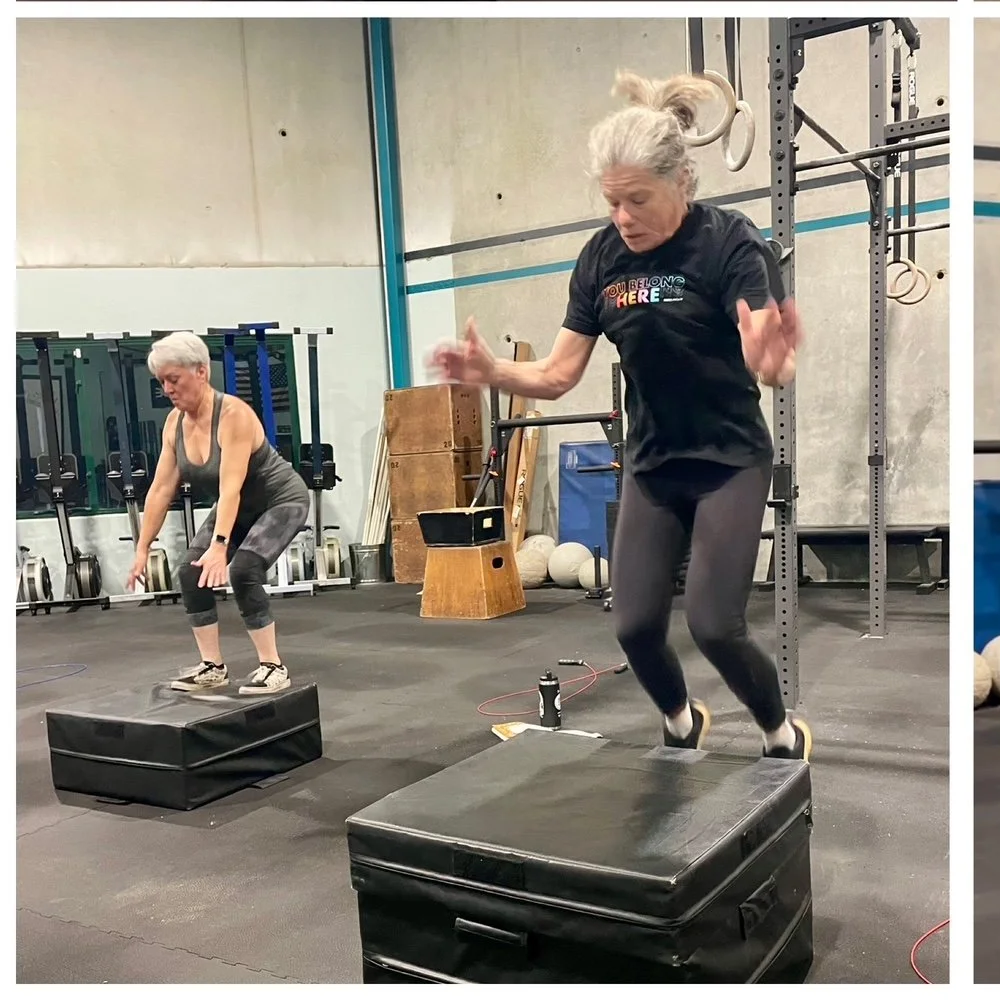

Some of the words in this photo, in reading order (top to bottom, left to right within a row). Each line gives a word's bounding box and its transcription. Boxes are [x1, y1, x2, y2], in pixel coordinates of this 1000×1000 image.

[603, 281, 626, 298] YOU
[628, 275, 686, 291] BELONG
[616, 287, 660, 308] HERE
[517, 469, 527, 503] RGUE
